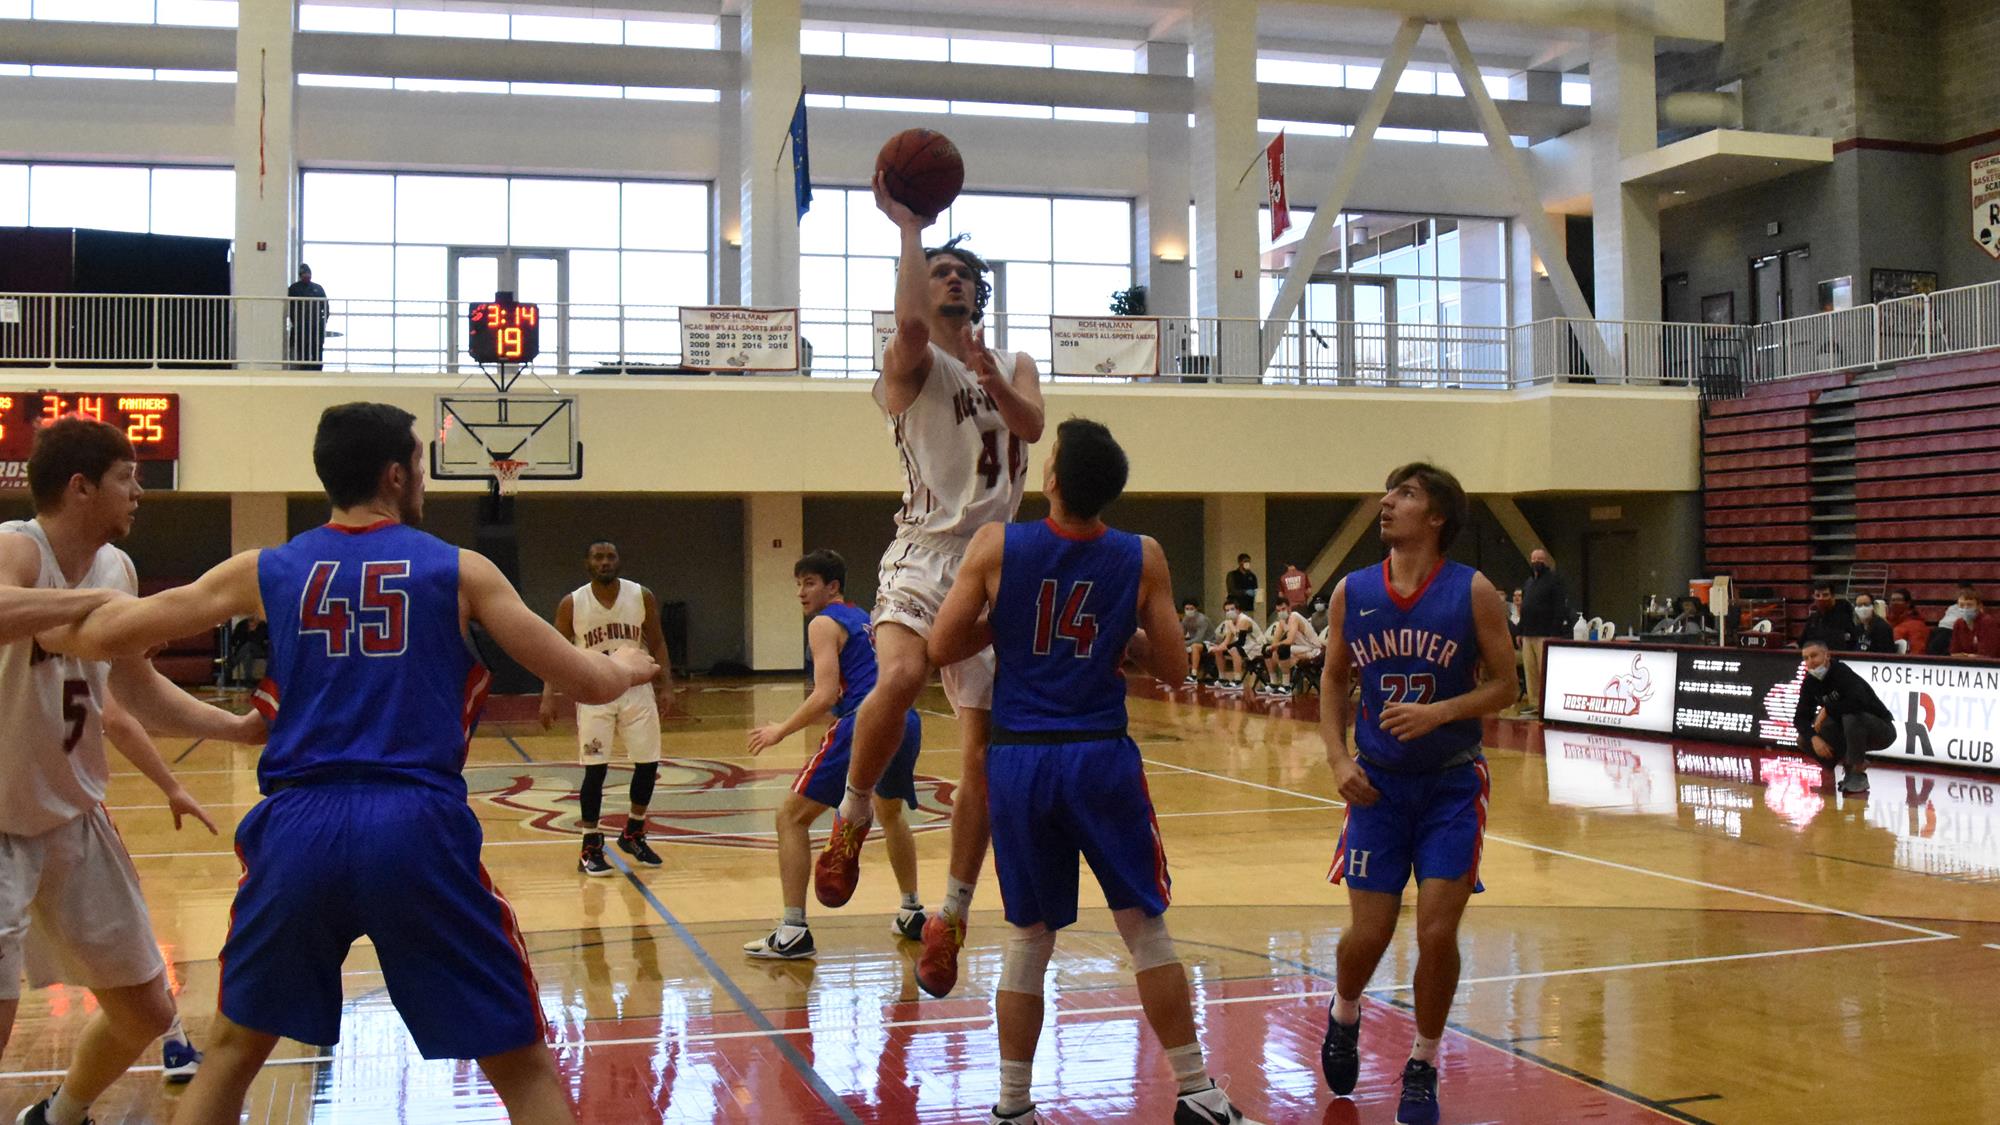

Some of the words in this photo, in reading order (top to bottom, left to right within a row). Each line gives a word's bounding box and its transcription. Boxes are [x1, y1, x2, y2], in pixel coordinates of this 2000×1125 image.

[487, 304, 535, 326] 3:14
[710, 312, 768, 321] ROSE-HULMAN
[1078, 320, 1132, 329] ROSE-HULMAN
[497, 328, 521, 357] 19
[742, 333, 762, 341] 2015
[1100, 332, 1135, 340] ALL-SPORTS
[43, 395, 102, 427] 3:14
[119, 398, 168, 410] PANTHERS
[128, 414, 163, 441] 25
[298, 560, 411, 657] 45
[1033, 579, 1099, 658] 14
[1351, 629, 1458, 668] HANOVER
[1381, 673, 1436, 704] 22
[1871, 665, 1999, 690] ROSE-HULMAN
[63, 679, 90, 755] 5
[1565, 695, 1627, 714] ROSE-HULMAN
[1587, 714, 1622, 725] ATHLETICS
[1947, 738, 1994, 763] CLUB
[1348, 848, 1372, 878] H
